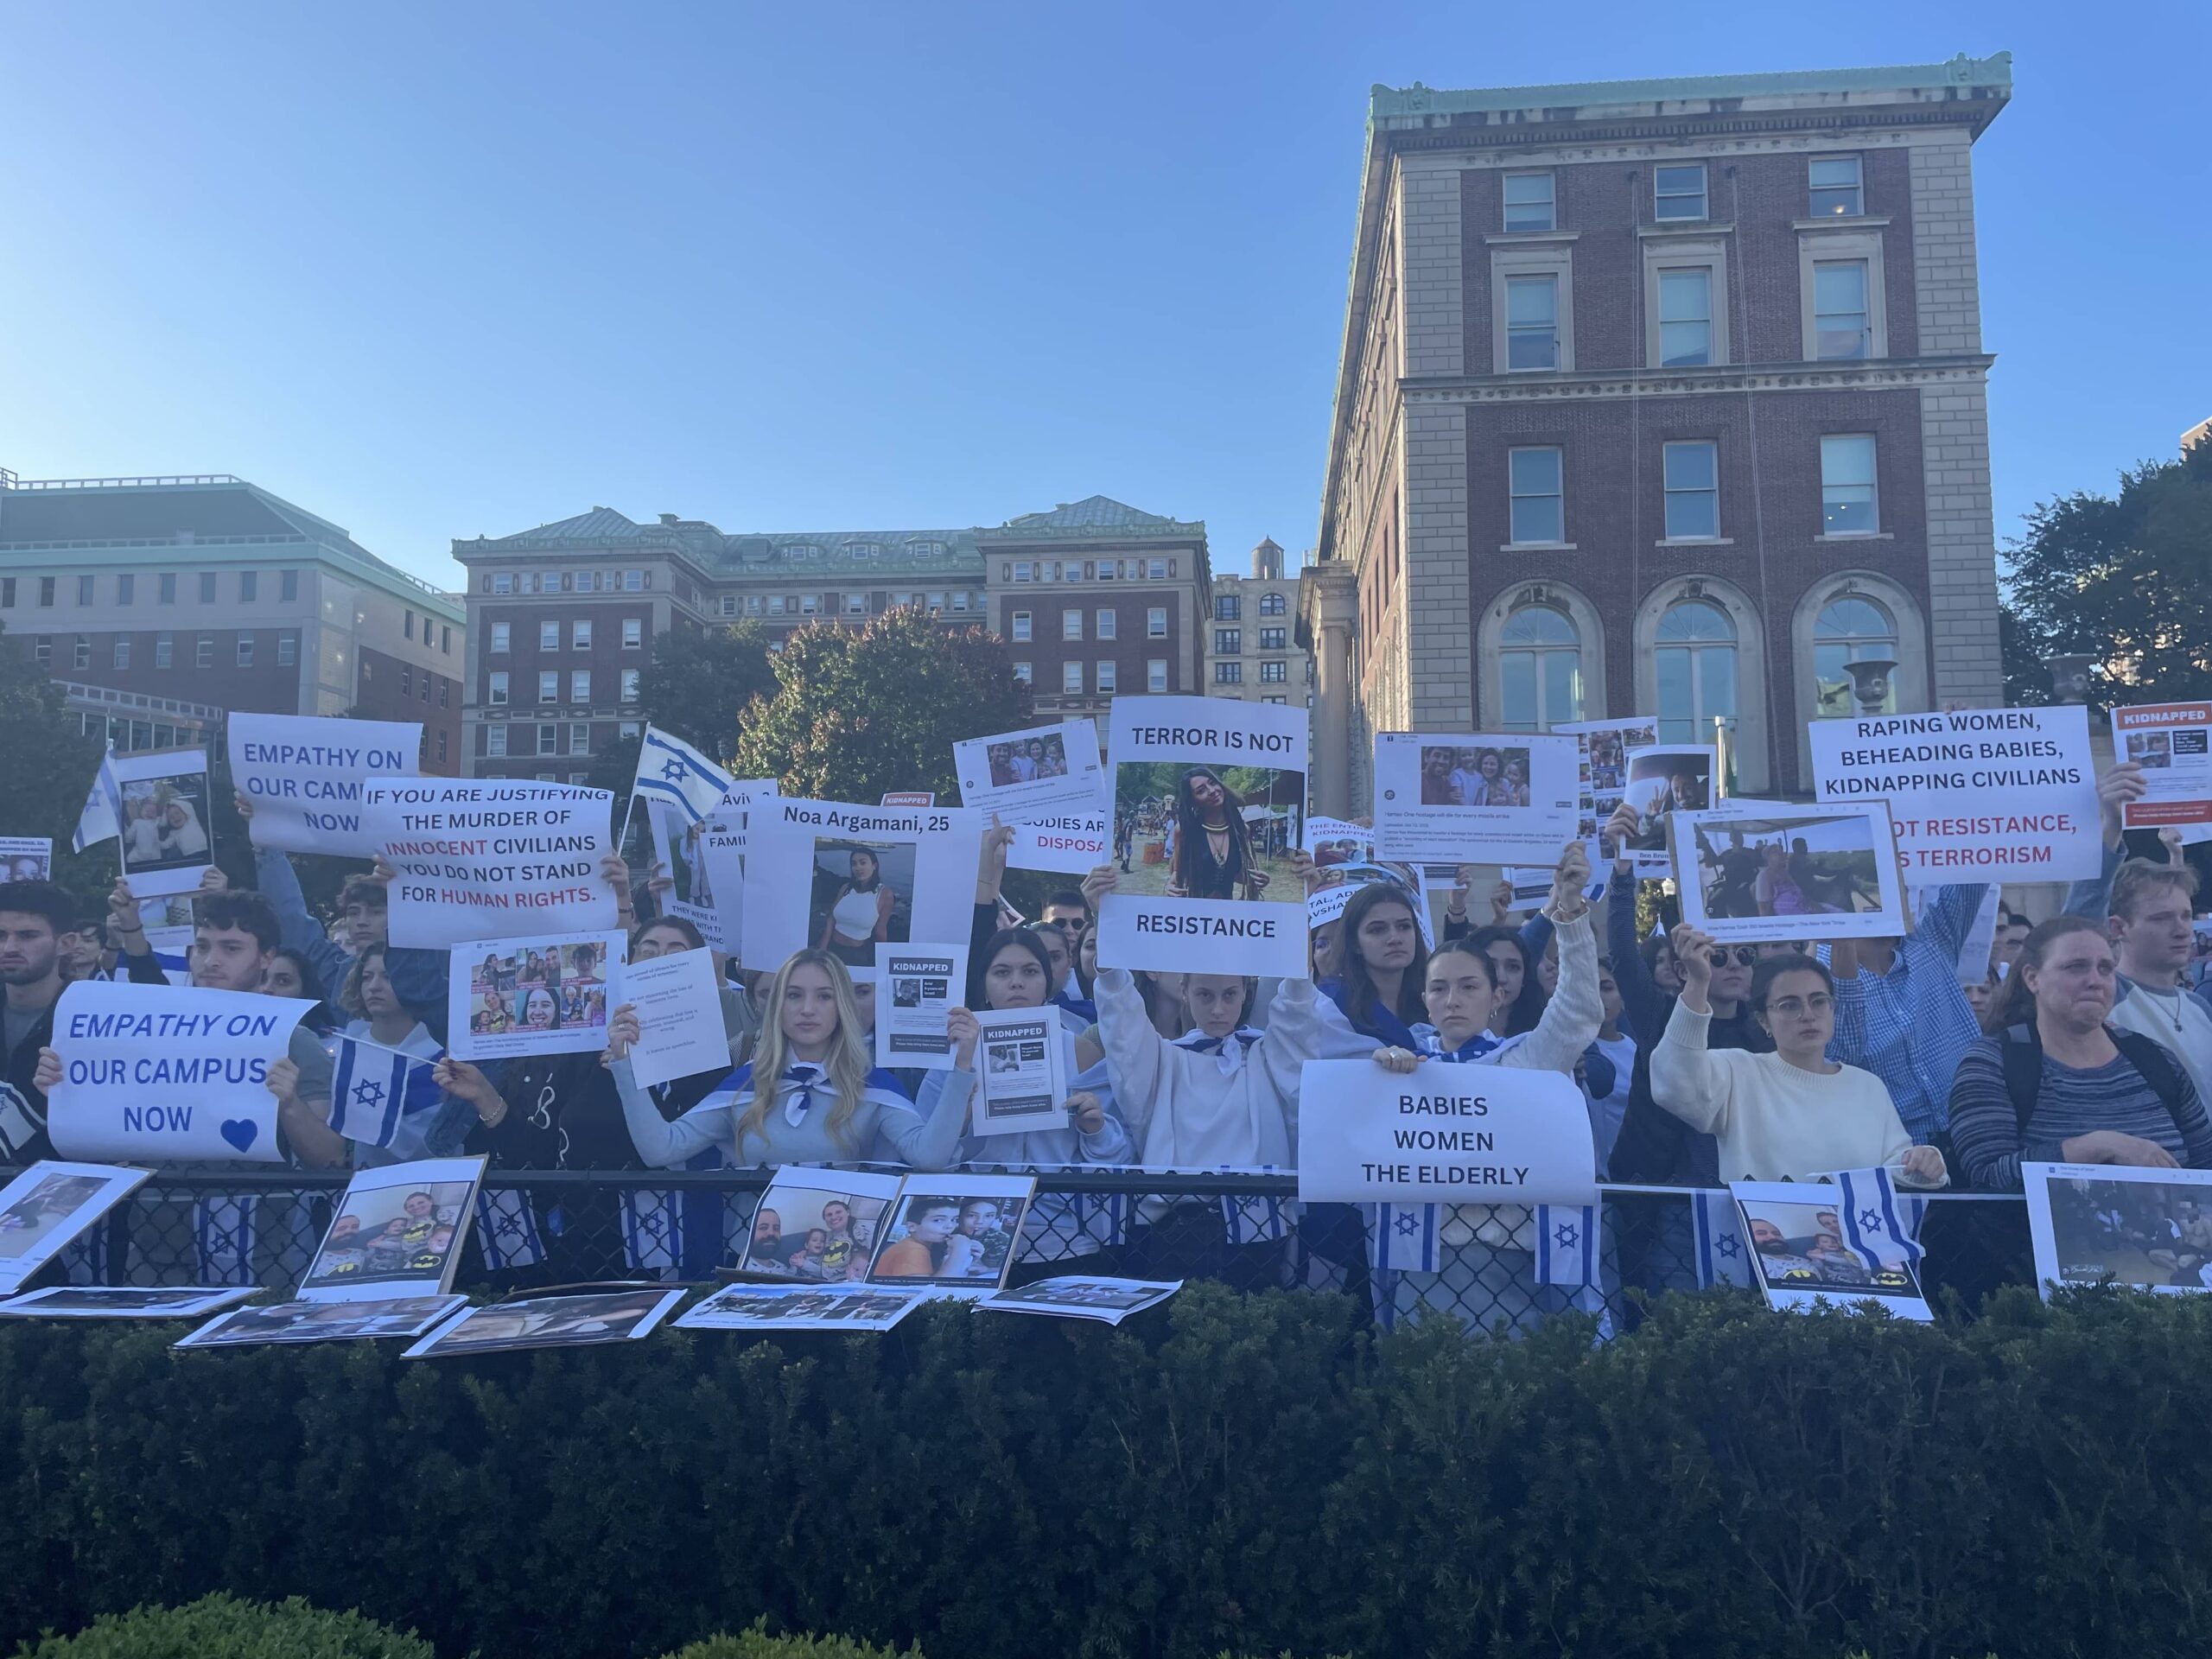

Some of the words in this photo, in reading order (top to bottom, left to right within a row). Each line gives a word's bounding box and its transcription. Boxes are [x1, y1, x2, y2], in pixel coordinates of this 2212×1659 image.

[1858, 717, 1942, 738] RAPING
[1948, 713, 2041, 732] WOMEN,
[2124, 710, 2206, 725] KIDNAPPED
[1132, 728, 1217, 747] TERROR
[1224, 730, 1243, 748] IS
[1249, 733, 1294, 753] NOT
[244, 743, 359, 767] EMPATHY
[366, 749, 402, 770] ON
[1841, 744, 1973, 766] BEHEADING
[1980, 741, 2063, 760] BABIES,
[247, 777, 297, 798] OUR
[304, 780, 364, 800] CAM
[1826, 772, 1965, 795] KIDNAPPING
[1972, 768, 2081, 788] CIVILIANS
[367, 790, 385, 804] IF
[391, 789, 435, 804] YOU
[441, 789, 482, 802] ARE
[486, 788, 609, 802] JUSTIFYING
[886, 796, 927, 804] KIDNAPPED
[303, 812, 359, 832] NOW
[402, 814, 442, 830] THE
[448, 810, 537, 829] MURDER
[543, 810, 571, 825] OF
[784, 805, 822, 825] Noa
[827, 810, 923, 835] Argamani,
[928, 816, 950, 831] 25
[1085, 820, 1104, 832] AR
[1894, 821, 1919, 838] OT
[1926, 815, 2077, 837] RESISTANCE,
[1038, 836, 1103, 852] DISPOSA
[1313, 830, 1375, 838] KIDNAPPED
[385, 840, 487, 855] INNOCENT
[493, 836, 595, 854] CIVILIANS
[1899, 850, 1910, 867] S
[1916, 846, 2051, 868] TERRORISM
[399, 864, 440, 878] YOU
[446, 867, 468, 880] DO
[475, 867, 515, 882] NOT
[522, 862, 591, 880] STAND
[402, 887, 435, 902] FOR
[442, 888, 509, 908] HUMAN
[515, 887, 596, 908] RIGHTS.
[1309, 897, 1332, 908] TAL,
[1335, 890, 1356, 899] AD
[671, 906, 690, 914] THEY
[690, 910, 709, 920] WERE
[1308, 902, 1344, 921] VSHA
[1136, 914, 1275, 938] RESISTANCE
[893, 963, 949, 972] KIDNAPPED
[69, 1014, 223, 1038] EMPATHY
[226, 1015, 277, 1037] ON
[988, 1027, 1043, 1039] KIDNAPPED
[69, 1059, 126, 1084] OUR
[135, 1058, 267, 1084] CAMPUS
[1400, 1095, 1488, 1116] BABIES
[124, 1106, 193, 1132] NOW
[1394, 1130, 1493, 1151] WOMEN
[1362, 1164, 1410, 1183] THE
[1418, 1166, 1529, 1185] ELDERLY
